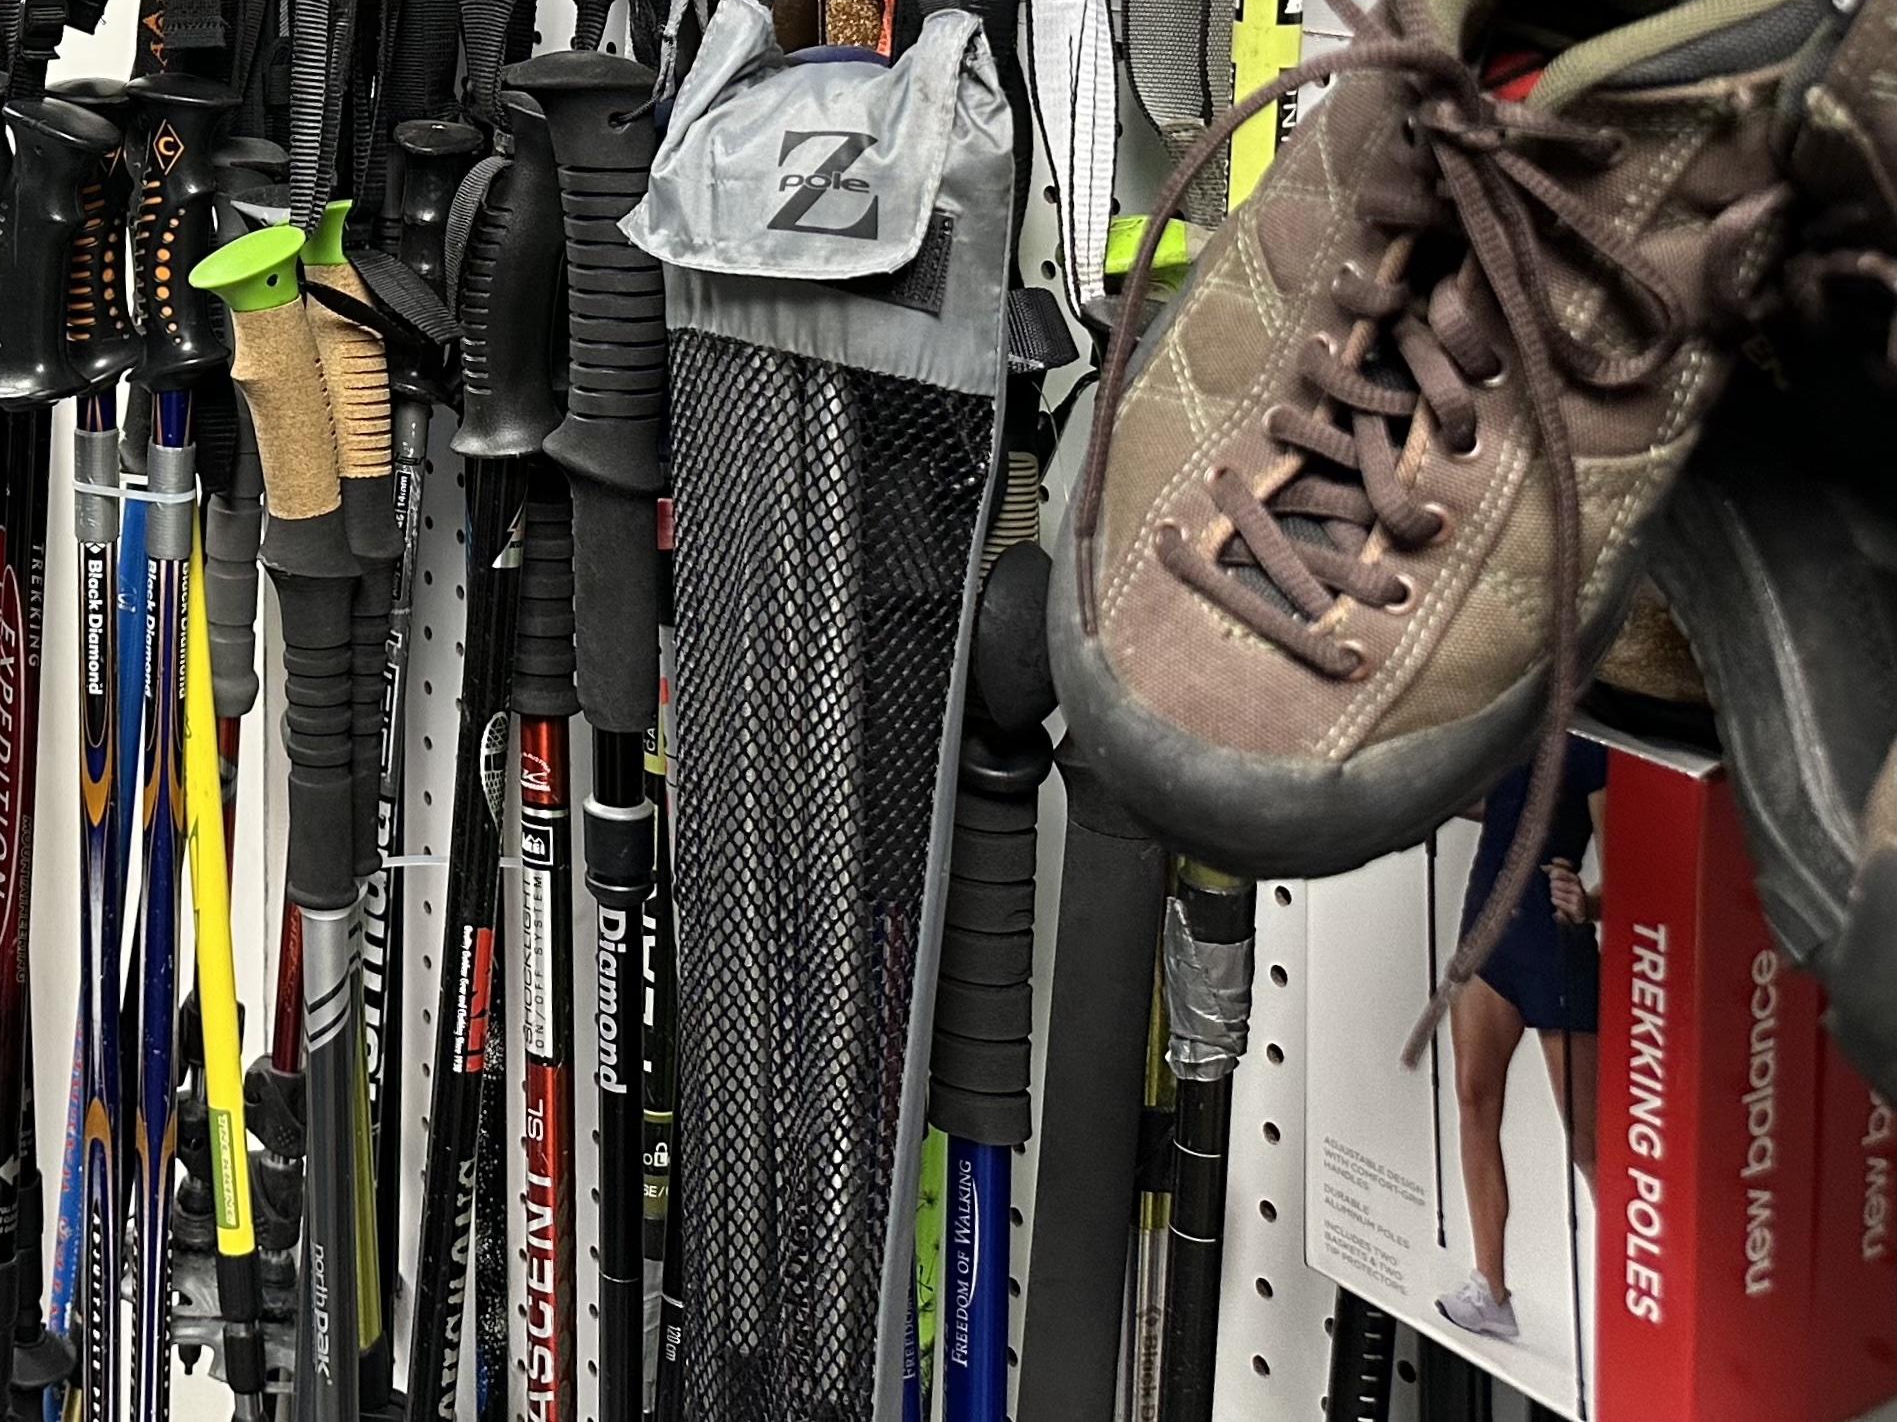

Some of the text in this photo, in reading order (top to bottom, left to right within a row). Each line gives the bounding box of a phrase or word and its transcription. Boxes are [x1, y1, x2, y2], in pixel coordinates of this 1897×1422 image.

[767, 130, 879, 241] Z
[778, 171, 871, 193] pole
[29, 541, 44, 668] TREKKING
[86, 559, 104, 696] Black Diamond
[144, 559, 159, 698] Black Diamond
[16, 814, 32, 983] MOUNTAINEERING
[524, 877, 534, 1046] SHOCKLIGHT
[533, 876, 544, 1050] ON/OFF SYSTEM
[598, 906, 627, 1095] Diamond
[527, 1098, 545, 1142] SL
[1624, 921, 1670, 1325] TREKKING POLES
[1740, 948, 1781, 1298] new balance
[952, 1159, 975, 1369] FREEDOM OF WALKING
[1324, 1184, 1369, 1216] DURABLE
[1324, 1197, 1374, 1233] ALUMINUM
[1324, 1220, 1371, 1251] INCLUDES
[309, 1241, 331, 1376] northpak
[526, 1171, 555, 1422] ASCENT
[665, 1324, 682, 1362] 120 cm
